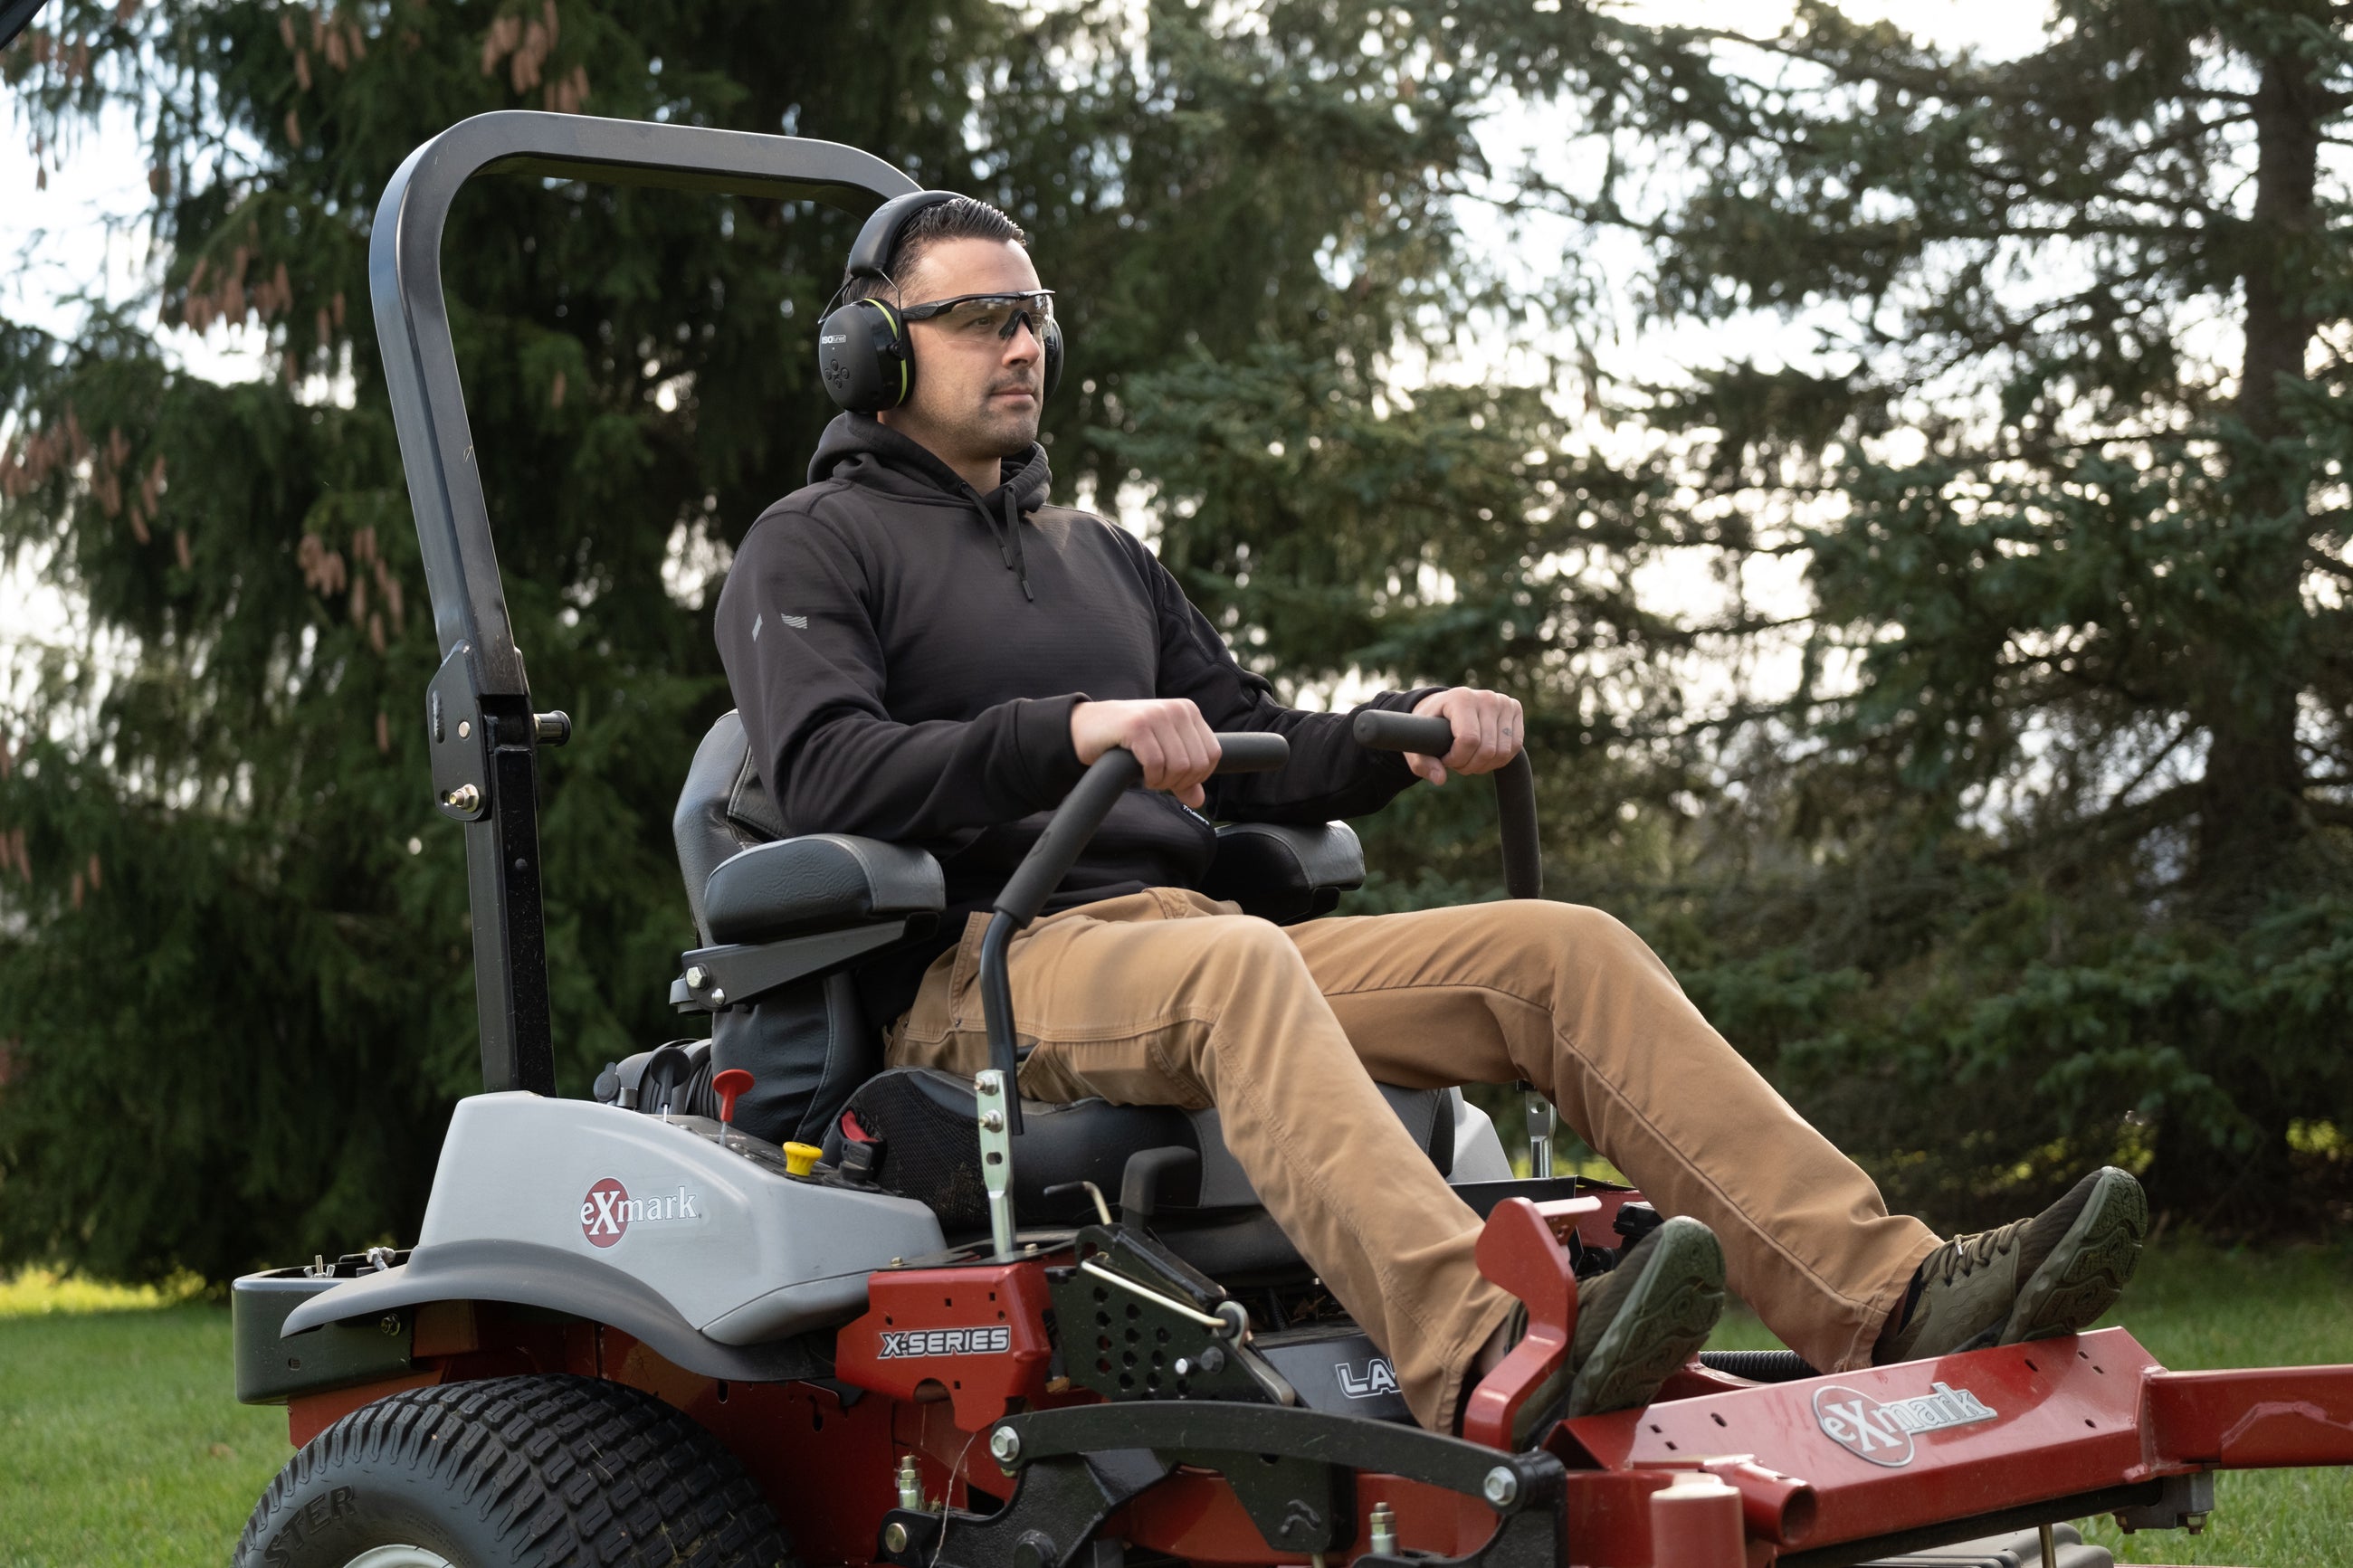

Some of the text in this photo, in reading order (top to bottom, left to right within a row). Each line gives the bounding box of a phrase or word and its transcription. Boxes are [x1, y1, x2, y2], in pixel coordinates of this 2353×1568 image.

[580, 1185, 697, 1236] eXmark
[880, 1327, 1009, 1357] X-SERIES
[1337, 1359, 1400, 1397] LA
[1823, 1383, 1991, 1452] eXmark
